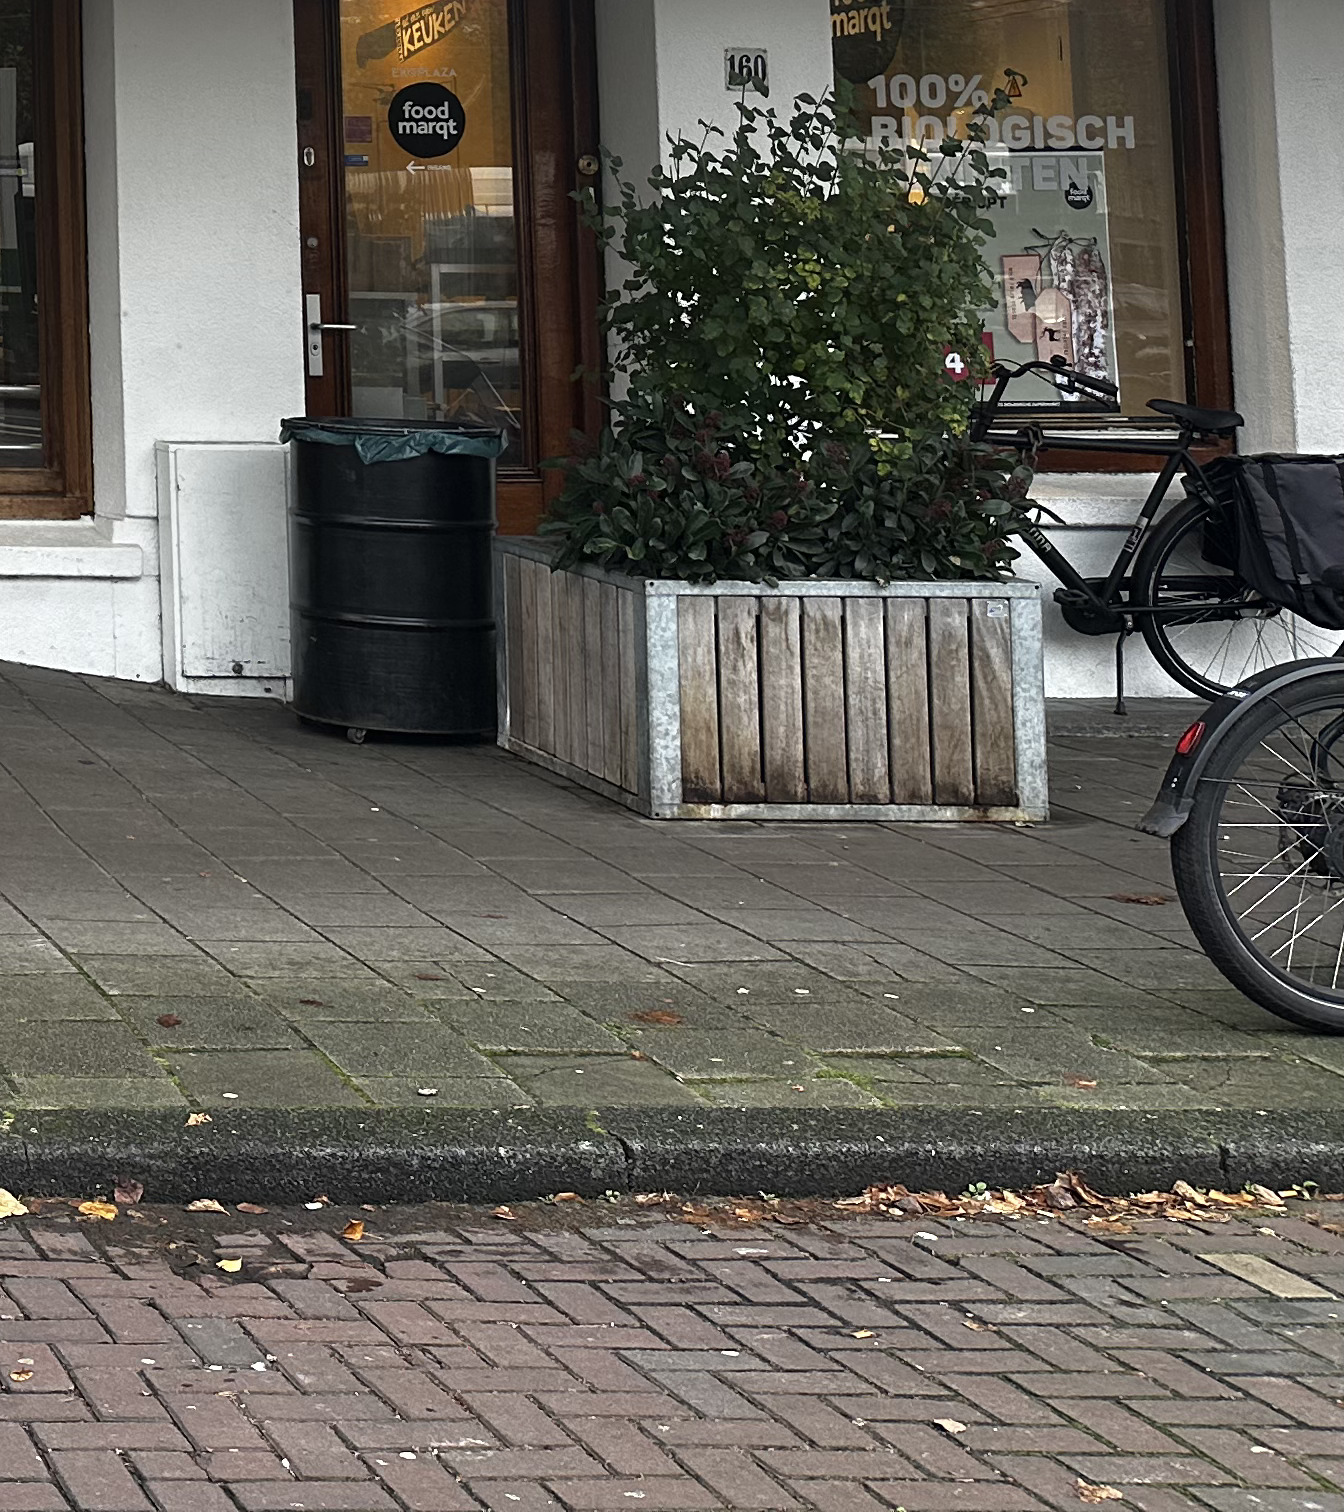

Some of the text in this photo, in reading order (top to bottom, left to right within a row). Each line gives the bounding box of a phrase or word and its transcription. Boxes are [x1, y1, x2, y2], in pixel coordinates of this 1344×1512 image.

[830, 0, 892, 42] marqt
[726, 53, 768, 87] 160
[867, 73, 989, 109] 100%
[402, 100, 450, 120] food
[397, 119, 458, 140] marqt
[944, 352, 965, 375] 4
